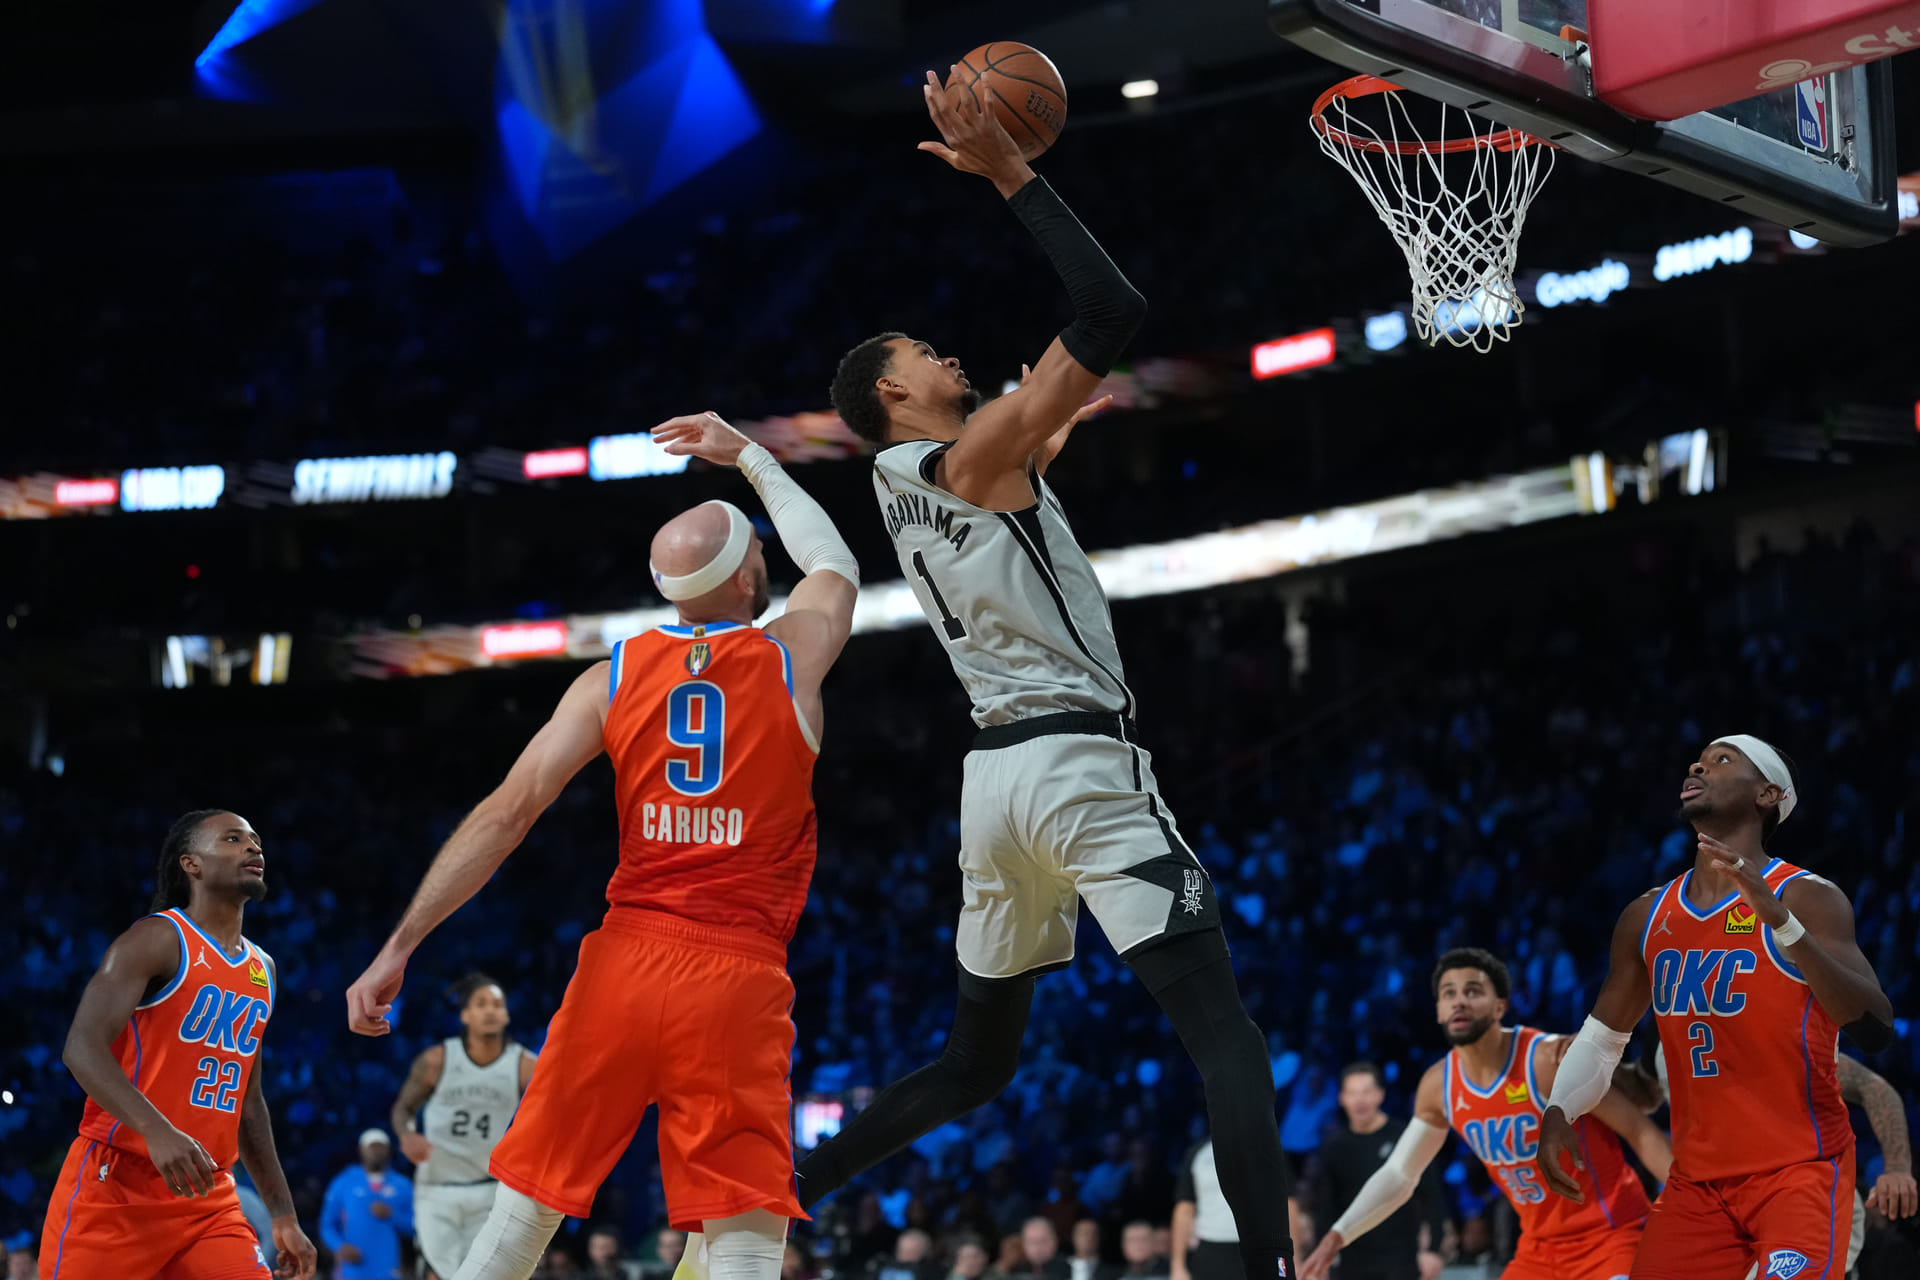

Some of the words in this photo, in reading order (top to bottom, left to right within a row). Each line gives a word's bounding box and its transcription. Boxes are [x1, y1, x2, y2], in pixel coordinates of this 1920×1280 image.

[1801, 118, 1818, 142] NBA
[912, 549, 969, 642] 1
[665, 680, 726, 797] 9
[642, 802, 744, 847] CARUSO
[1652, 948, 1757, 1017] OKC
[178, 984, 269, 1057] OKC
[1688, 1021, 1720, 1078] 2
[190, 1056, 242, 1114] 22
[450, 1109, 491, 1140] 24
[1463, 1112, 1539, 1166] OKC
